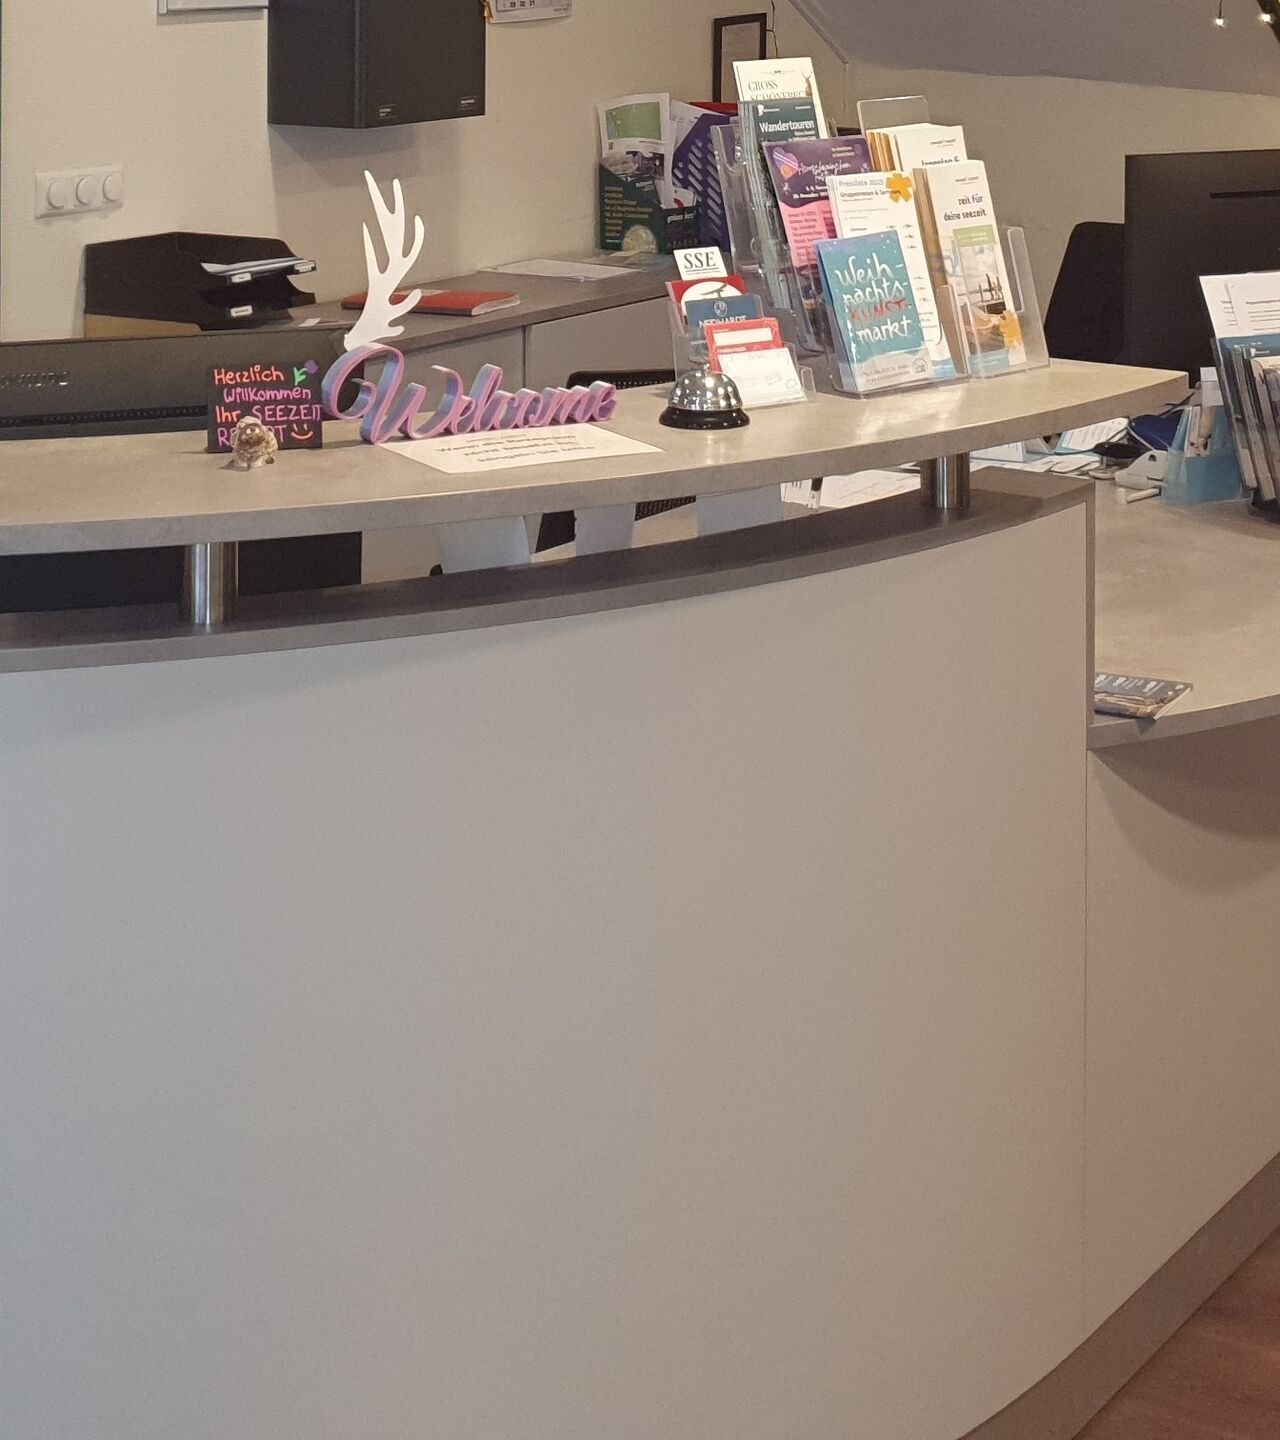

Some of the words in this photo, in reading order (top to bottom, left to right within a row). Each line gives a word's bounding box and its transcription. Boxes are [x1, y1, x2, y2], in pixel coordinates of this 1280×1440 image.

[759, 120, 815, 133] Wandertouren
[957, 194, 972, 205] zeit
[972, 193, 984, 203] für
[943, 210, 961, 222] deine
[684, 251, 717, 269] SSE
[856, 314, 911, 344] markt
[214, 365, 284, 385] Herzlich
[321, 343, 617, 444] Welcome
[215, 406, 241, 423] Ihr
[252, 404, 322, 420] SEEZEIT
